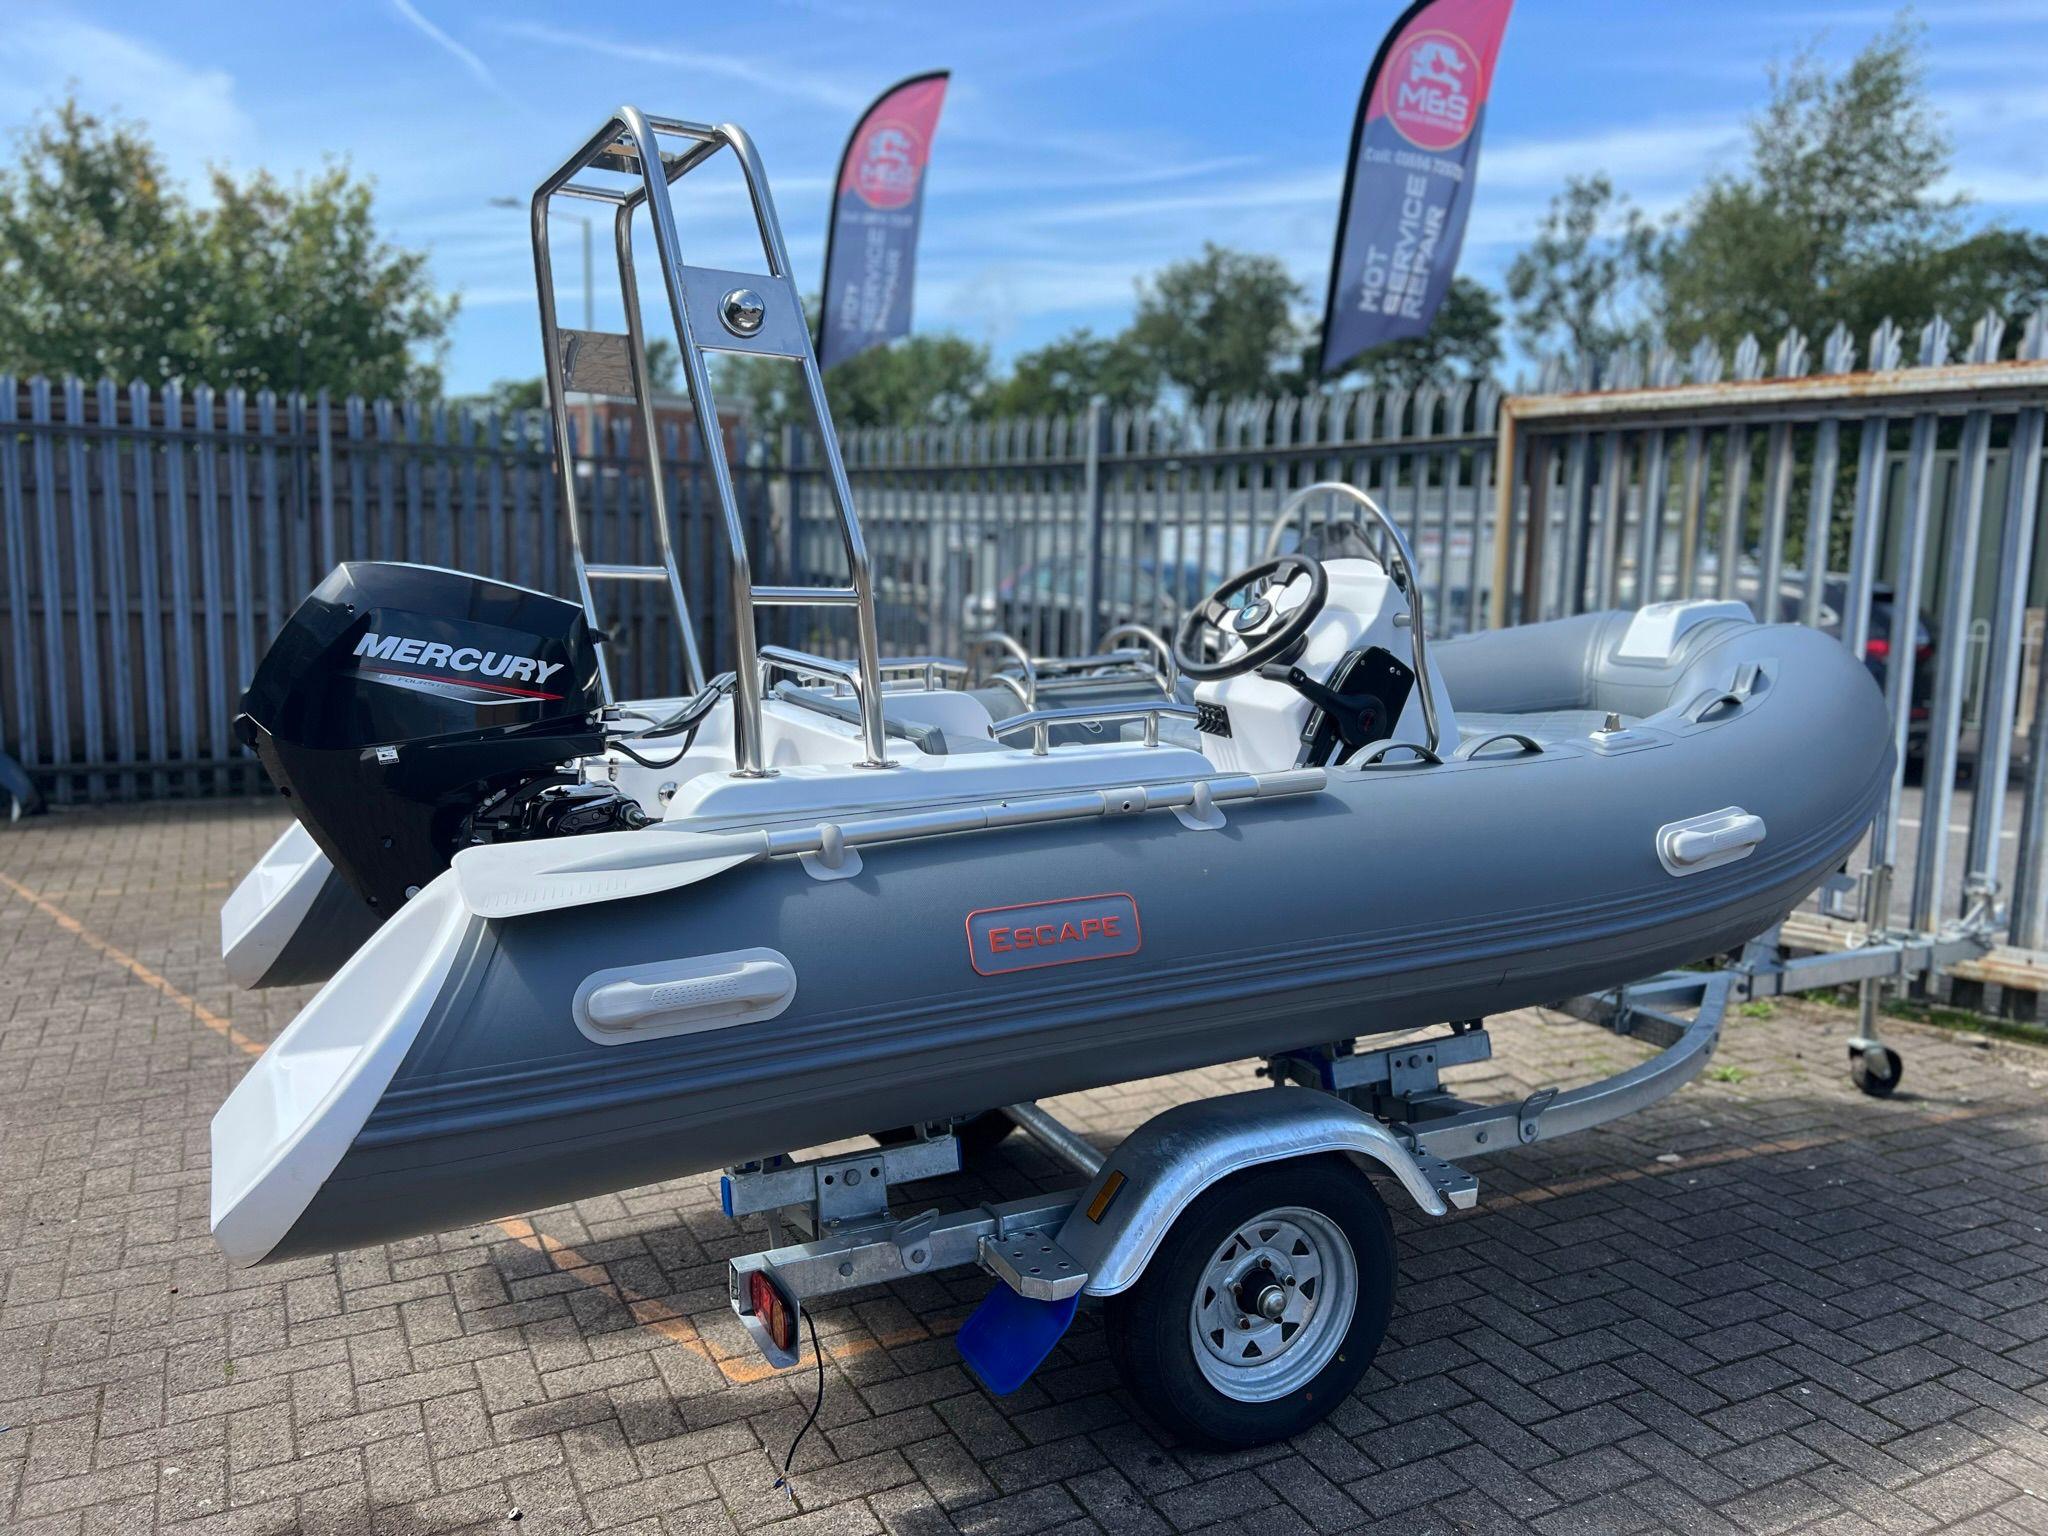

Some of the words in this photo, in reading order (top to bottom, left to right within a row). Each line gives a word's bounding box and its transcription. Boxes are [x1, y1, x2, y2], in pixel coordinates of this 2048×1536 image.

[1359, 245, 1388, 314] MOT
[1382, 174, 1428, 316] SERVICE
[1401, 205, 1447, 319] REPAIR
[353, 632, 565, 684] MERCURY
[988, 915, 1122, 953] ESCAPE
